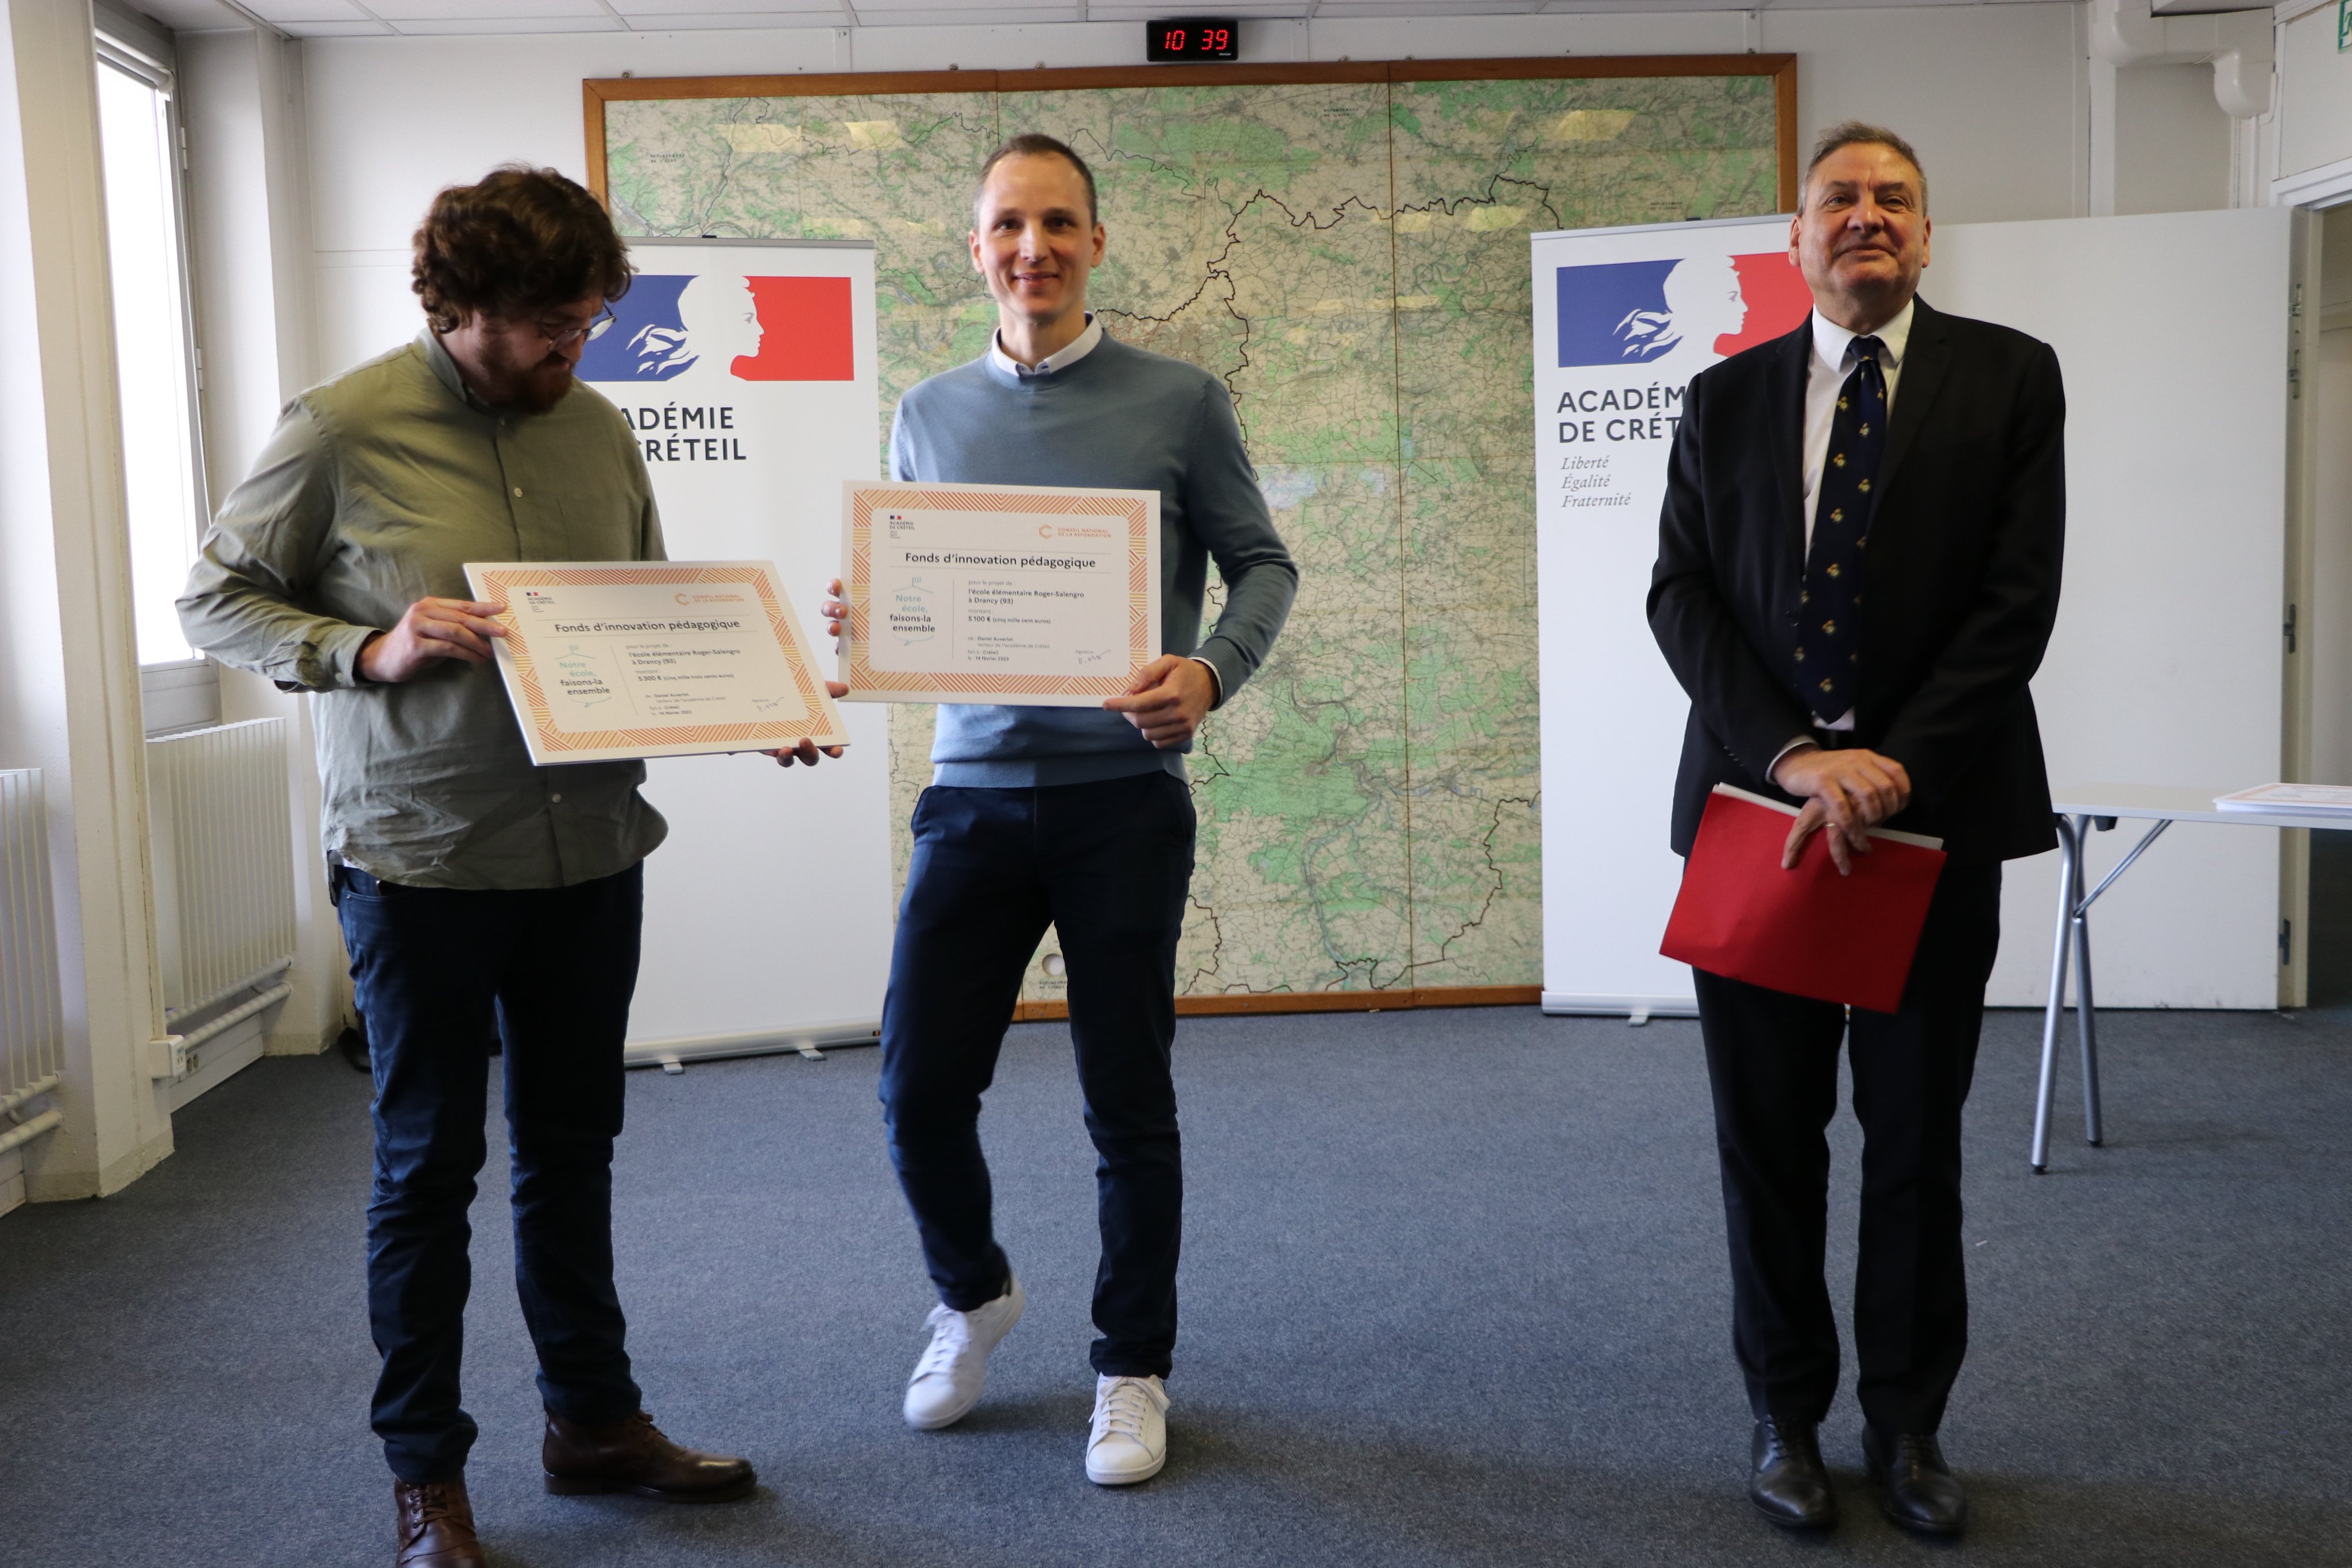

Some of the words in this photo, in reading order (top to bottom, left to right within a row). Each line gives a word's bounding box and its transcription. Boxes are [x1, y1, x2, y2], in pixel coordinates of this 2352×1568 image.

[1165, 30, 1185, 50] 10
[1201, 30, 1228, 50] 39
[1557, 382, 1686, 413] ACADÉM
[621, 401, 734, 430] ADÉMIE
[1559, 421, 1595, 443] DE
[1606, 412, 1682, 442] CRÉT
[637, 433, 747, 462] RÉTEIL
[1561, 455, 1610, 470] Liberté
[1561, 473, 1611, 492] Égalité
[1561, 492, 1632, 508] Fraternité
[906, 552, 940, 563] Fonds
[944, 553, 1017, 565] d'innovation
[1021, 556, 1096, 570] pédagogique
[974, 597, 998, 605] Drancy
[1034, 590, 1085, 599] Roger-Salengro
[902, 605, 928, 613] école,
[890, 614, 931, 622] faisons-la
[555, 622, 590, 632] Fonds
[594, 621, 666, 632] d'innovation
[669, 620, 740, 631] pédagogique
[893, 624, 935, 632] ensemble
[560, 678, 604, 686] faisons-la
[567, 687, 611, 695] ensemble
